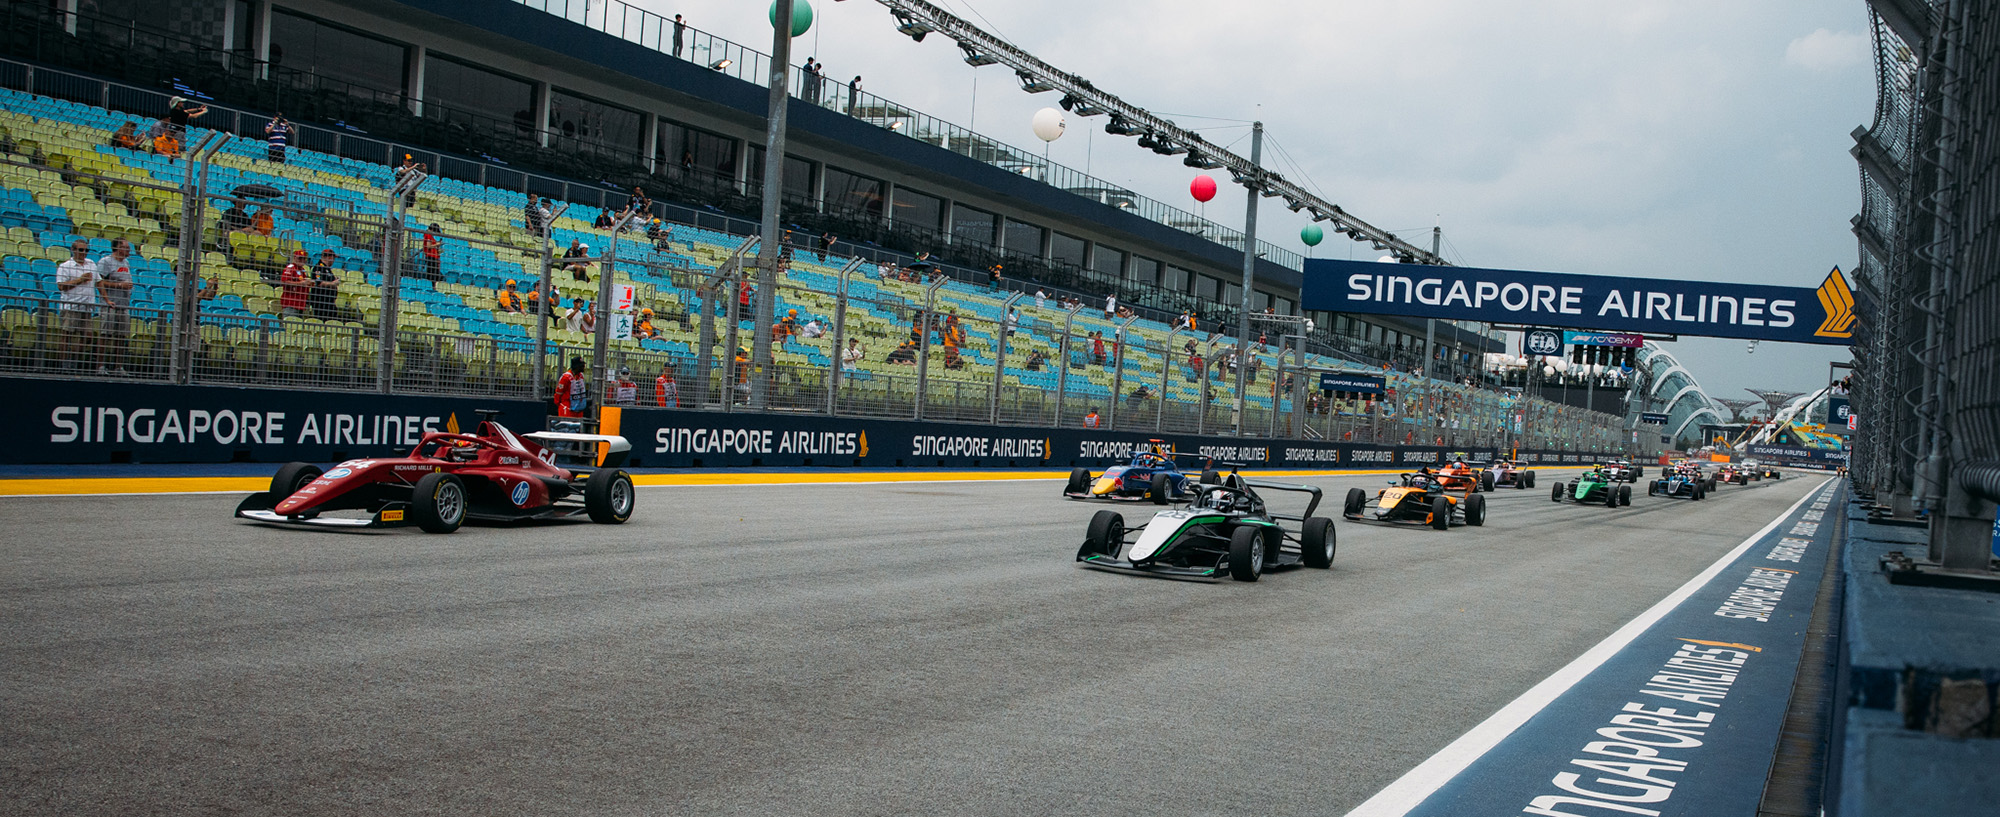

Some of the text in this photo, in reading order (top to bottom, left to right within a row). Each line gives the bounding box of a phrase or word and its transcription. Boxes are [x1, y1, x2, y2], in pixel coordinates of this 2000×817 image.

[1347, 273, 1796, 328] SINGAPORE AIRLINES
[1531, 335, 1555, 348] FIA
[1591, 335, 1636, 345] ACADEMY
[51, 406, 441, 445] SINGAPORE AIRLINES
[655, 427, 856, 455] SINGAPORE AIRLINES
[912, 434, 1043, 457] SINGAPORE AIRLINES
[1079, 440, 1132, 458] SINGAPORE
[538, 448, 560, 471] 64
[1199, 446, 1266, 461] SINGAPORE AIRLINES
[1285, 448, 1314, 461] SINGAPORE
[514, 481, 528, 504] hp
[1638, 643, 1749, 708] AIRLINES
